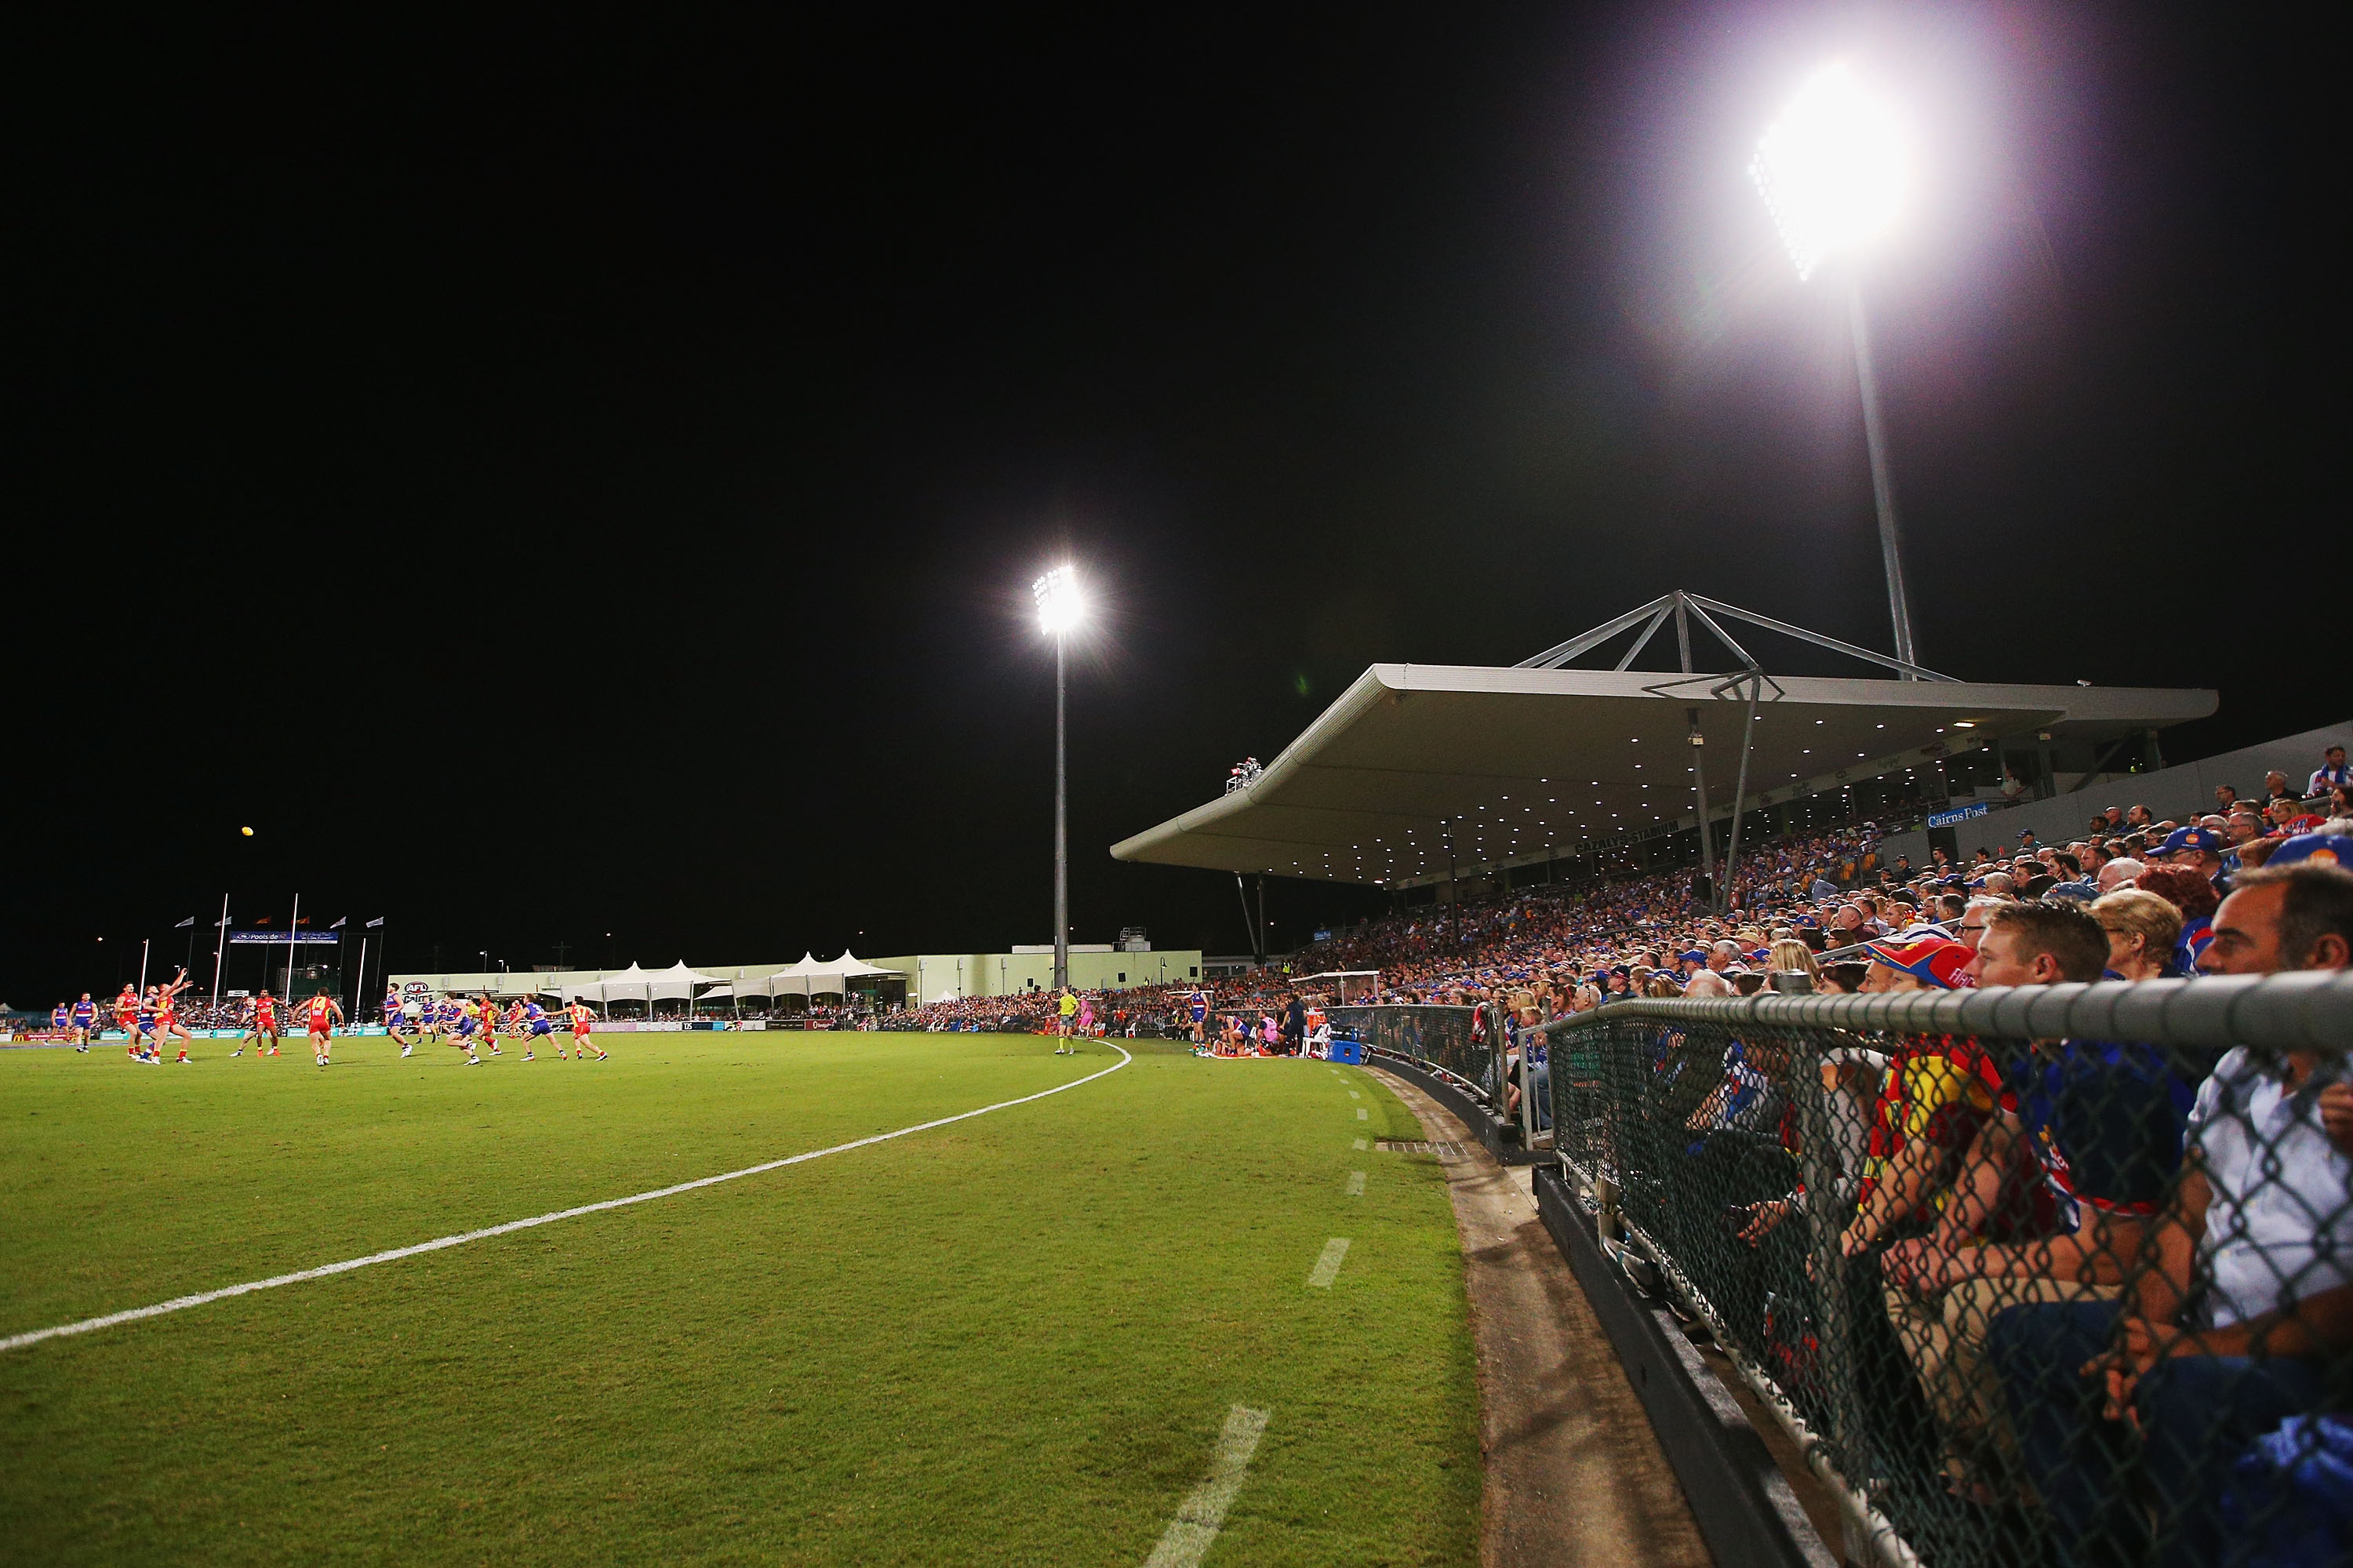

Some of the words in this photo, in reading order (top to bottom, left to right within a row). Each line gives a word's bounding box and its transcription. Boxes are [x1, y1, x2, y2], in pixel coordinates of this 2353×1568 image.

[1928, 812, 1963, 828] Cairns
[1964, 805, 1988, 820] Post
[1631, 820, 1679, 842] STADIUM
[311, 996, 327, 1010] 14
[574, 1005, 587, 1017] 37
